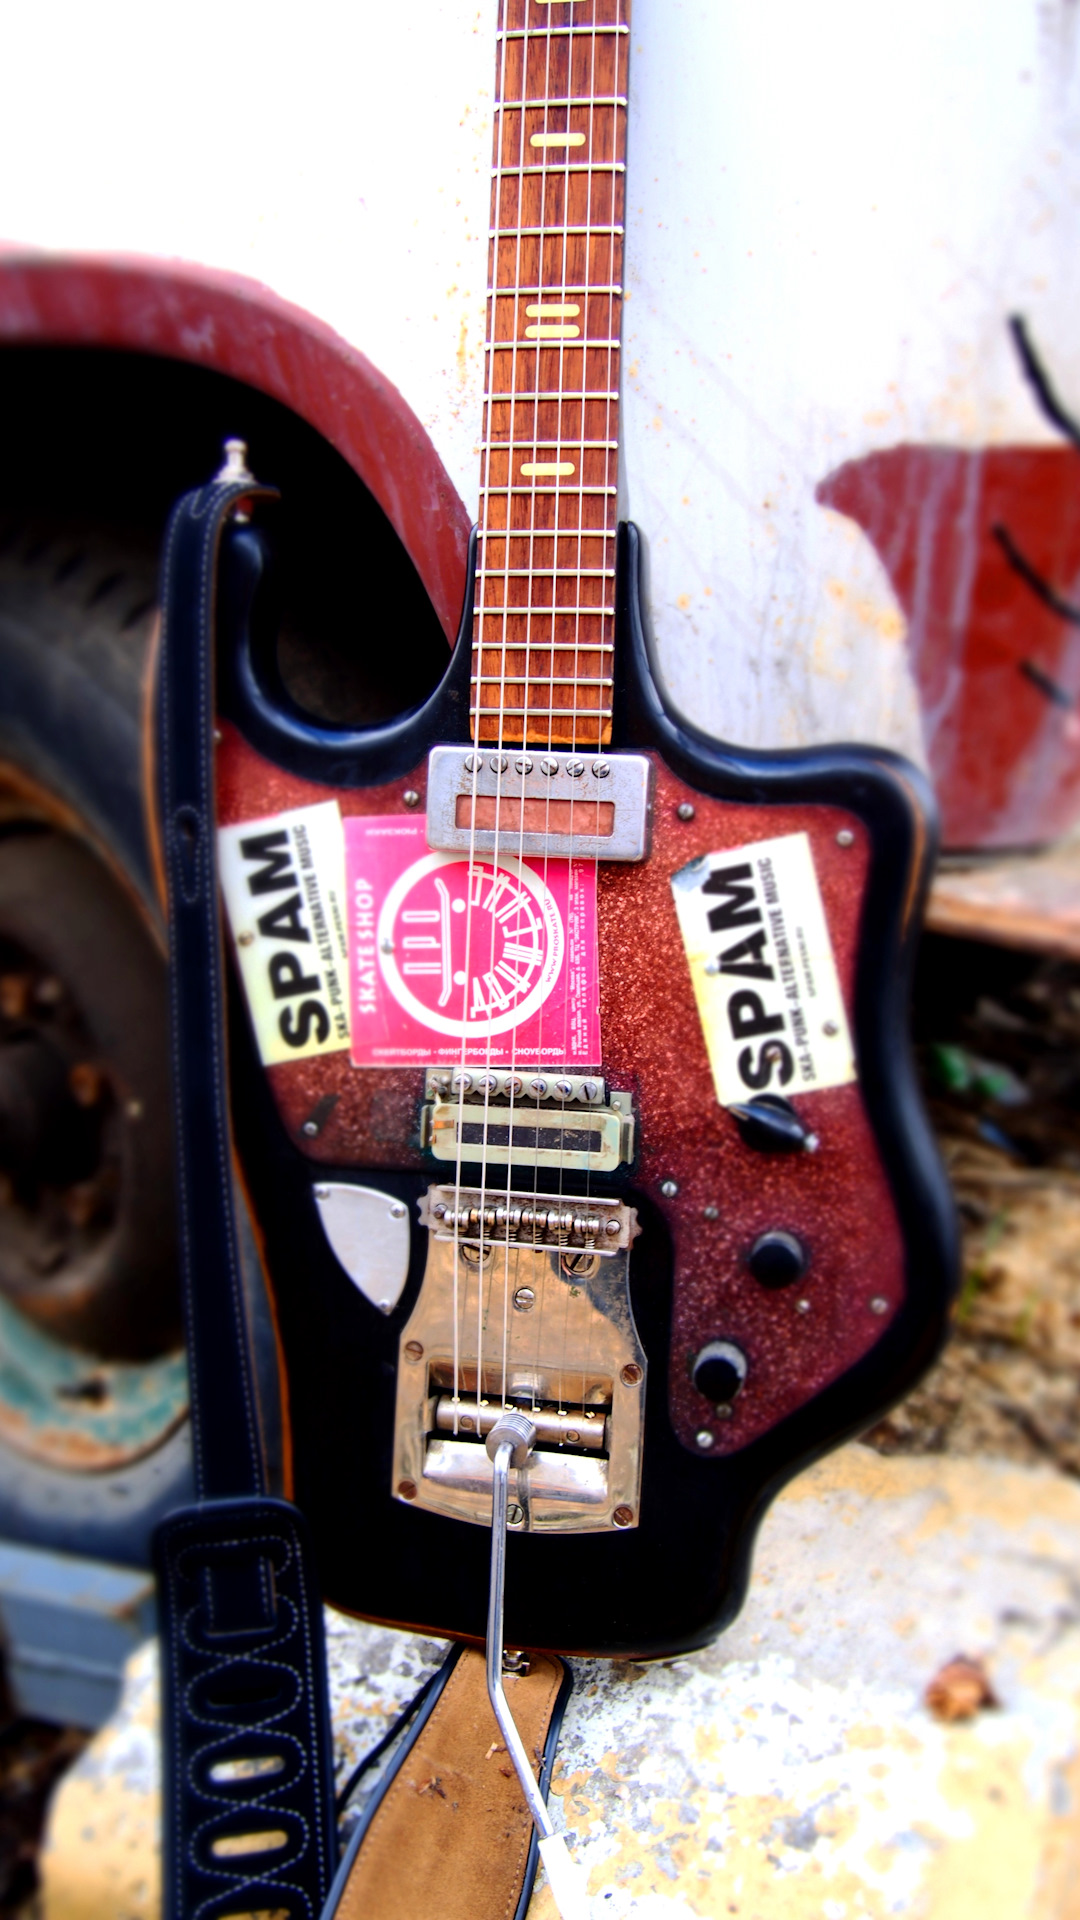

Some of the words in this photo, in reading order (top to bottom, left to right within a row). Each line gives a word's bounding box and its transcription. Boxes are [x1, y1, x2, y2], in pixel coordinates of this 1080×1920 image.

[292, 824, 313, 870] MUSIC
[355, 878, 374, 939] SHOP
[757, 857, 780, 905] MUSIC
[239, 829, 331, 1049] SPAM
[357, 945, 377, 1014] SKATE
[701, 863, 795, 1090] SPAM
